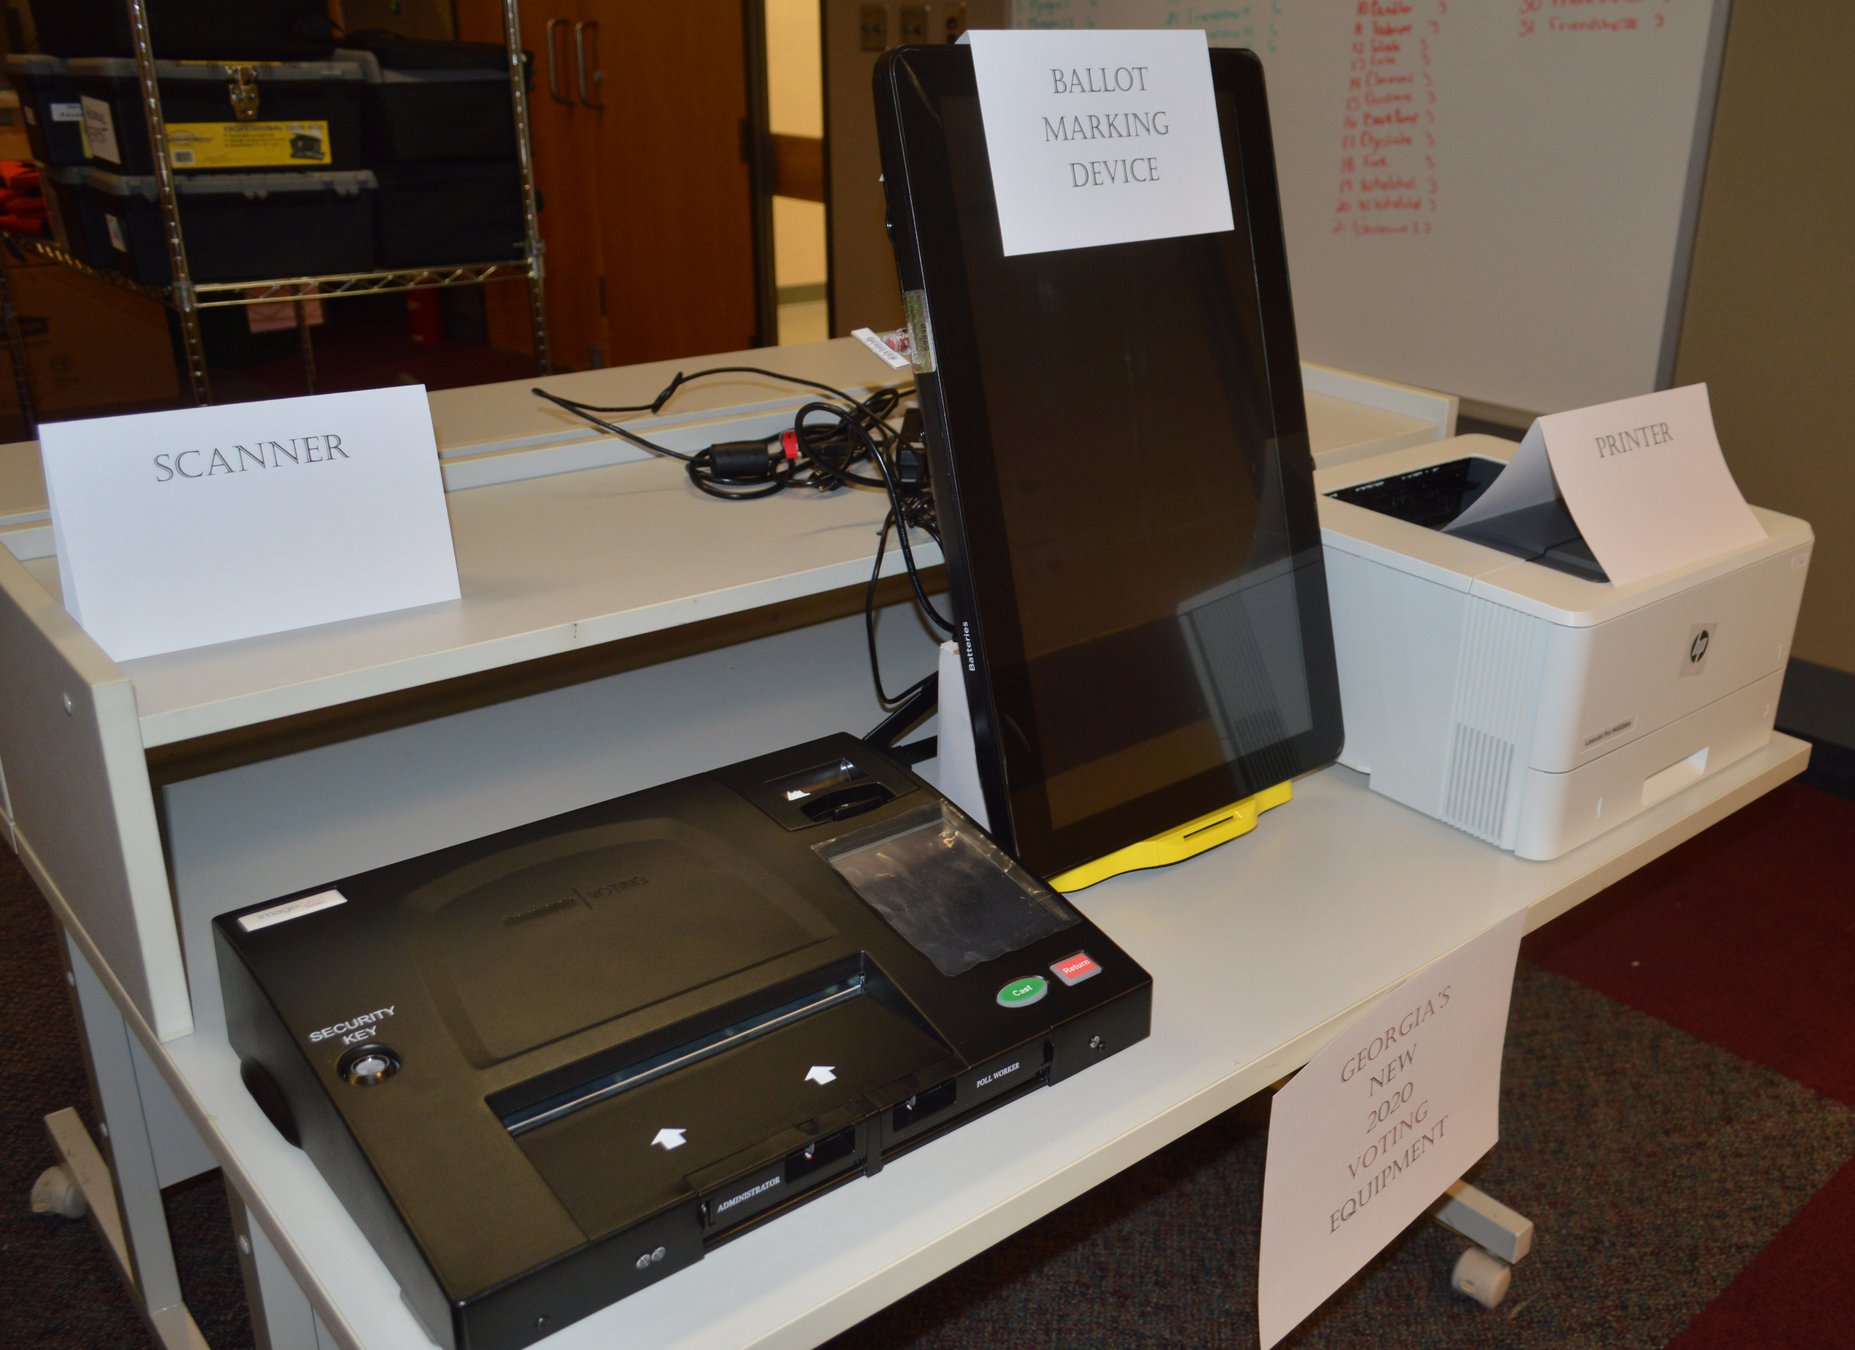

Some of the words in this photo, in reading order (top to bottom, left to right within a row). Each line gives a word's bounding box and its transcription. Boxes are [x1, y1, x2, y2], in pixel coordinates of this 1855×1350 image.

[1050, 66, 1149, 95] BALLOT
[1042, 110, 1170, 142] MARKING
[1070, 157, 1160, 188] DEVICE
[153, 433, 350, 483] SCANNER
[1595, 421, 1674, 460] PRINTER
[962, 621, 976, 672] Batteries
[1062, 957, 1091, 976] Return
[1012, 984, 1033, 998] Cast
[309, 1004, 395, 1043] SECURITY
[342, 1025, 377, 1046] KEY
[1340, 985, 1451, 1084] GEORGIA'S
[976, 1072, 992, 1088] POLL
[993, 1062, 1020, 1083] WORKER
[1368, 1043, 1418, 1097] NEW
[1366, 1081, 1415, 1134] 2020
[1346, 1099, 1429, 1181] VOTING
[717, 1176, 781, 1212] ADMINISTRATOR
[1328, 1115, 1449, 1236] EQUIPMENT
